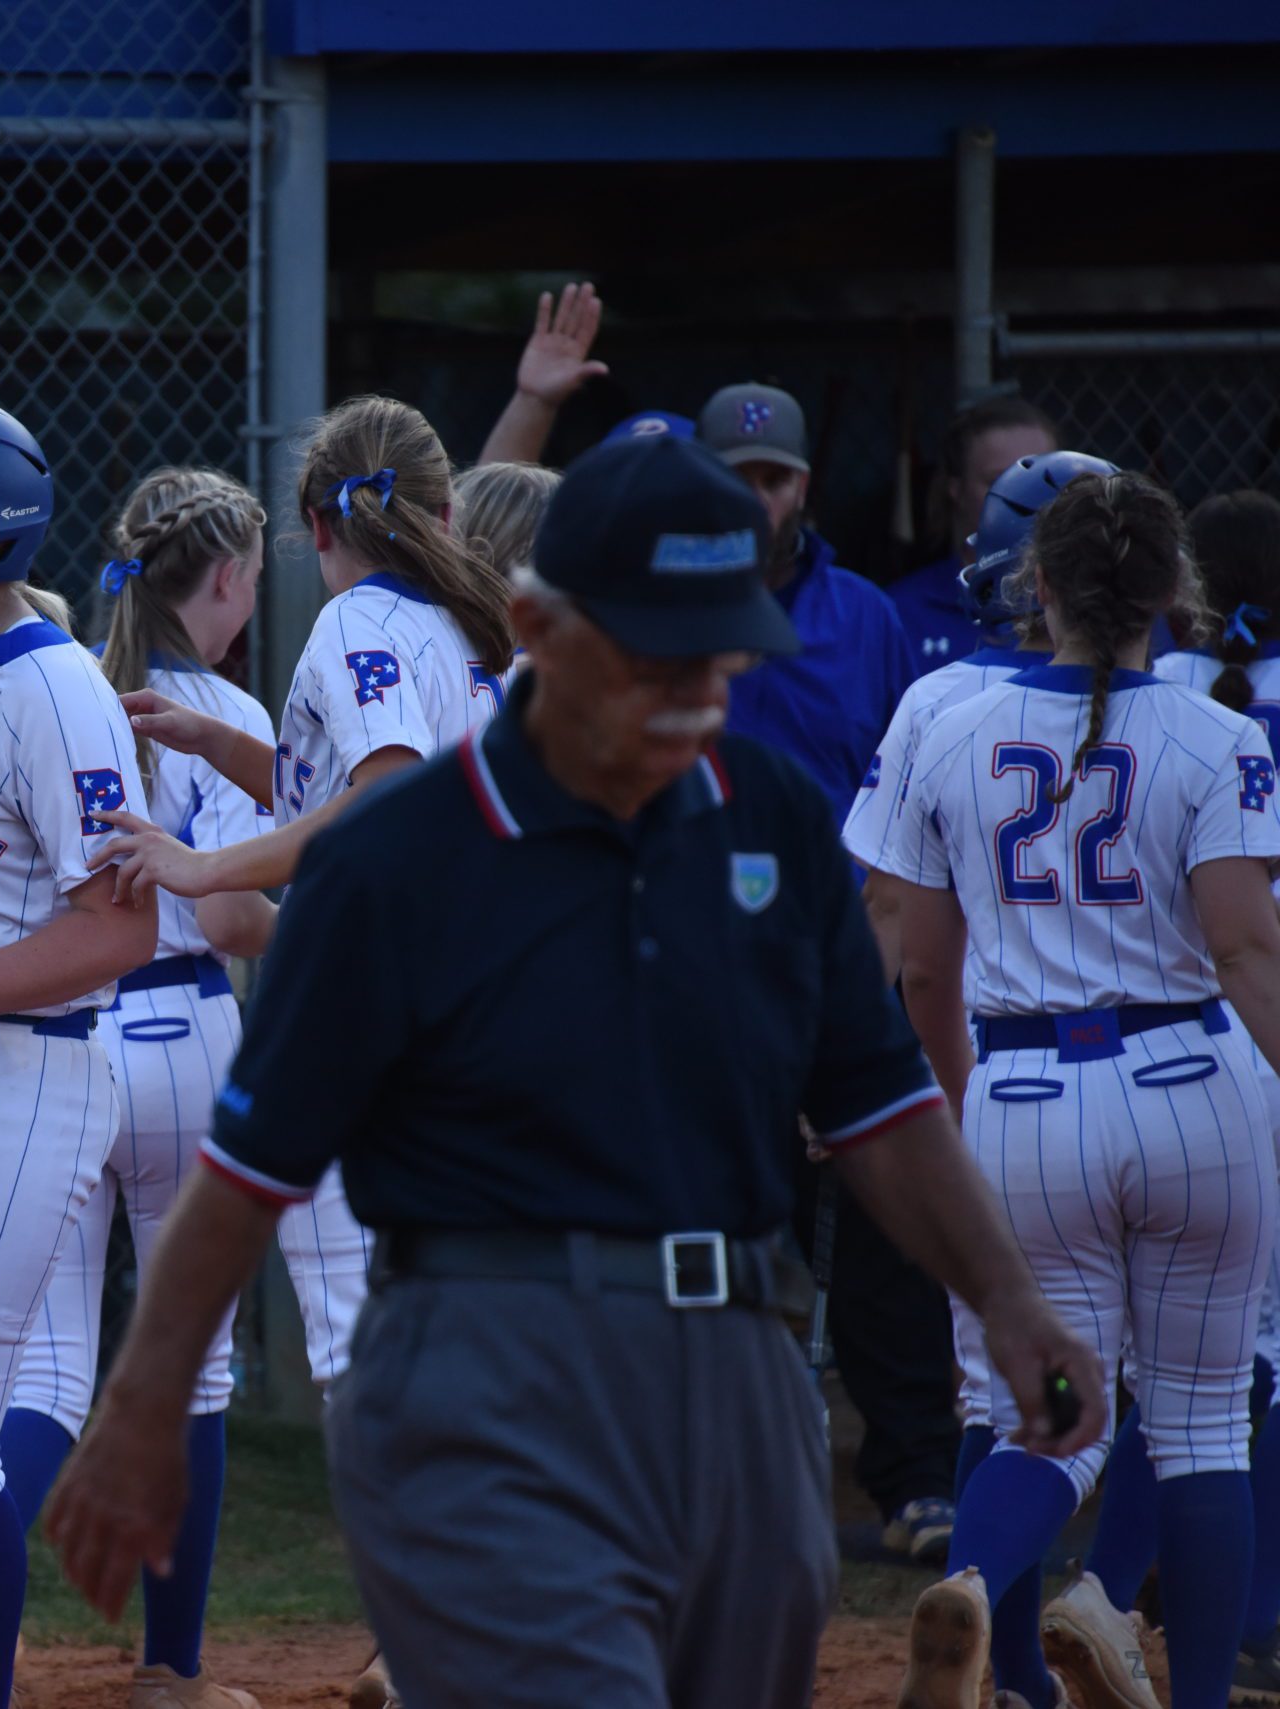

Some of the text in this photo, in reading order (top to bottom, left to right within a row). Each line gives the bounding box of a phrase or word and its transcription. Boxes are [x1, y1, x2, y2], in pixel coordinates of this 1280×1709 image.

[10, 505, 40, 517] EASTON
[345, 650, 401, 707] P
[72, 768, 126, 836] P
[1236, 755, 1275, 813] P
[992, 741, 1144, 906] 22
